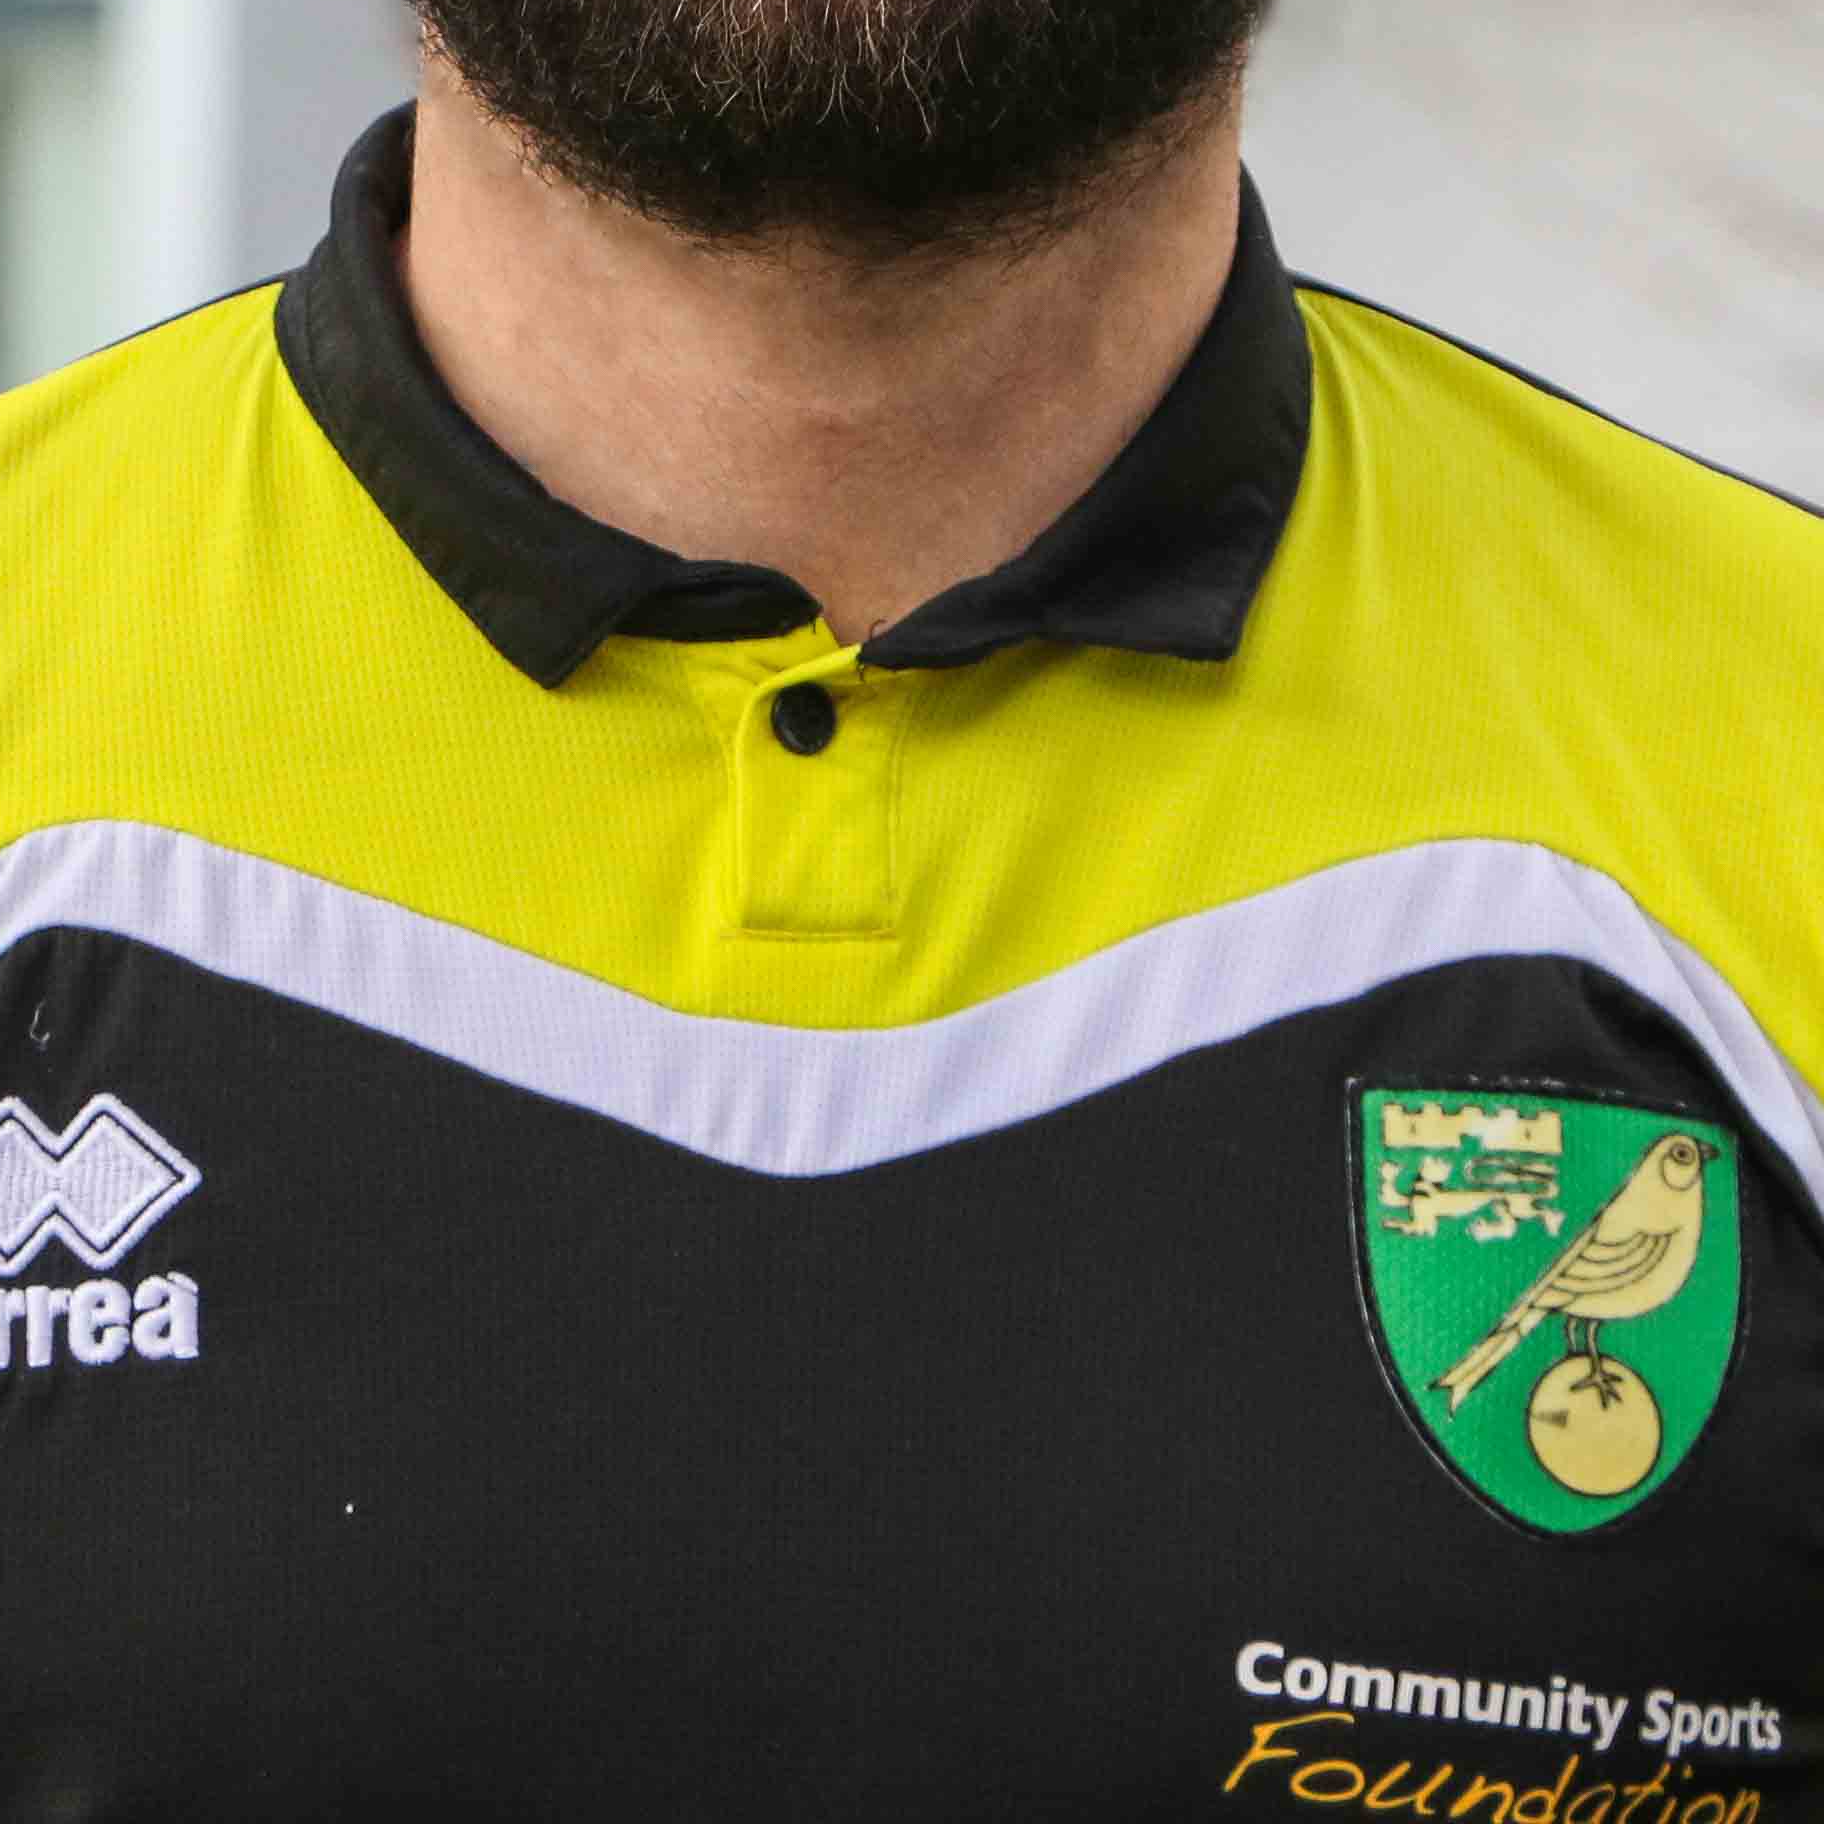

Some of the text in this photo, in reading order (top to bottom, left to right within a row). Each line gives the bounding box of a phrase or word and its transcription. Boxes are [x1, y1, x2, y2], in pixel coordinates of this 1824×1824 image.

[1235, 1640, 1782, 1756] Community Sports
[1223, 1711, 1762, 1824] Foundation
